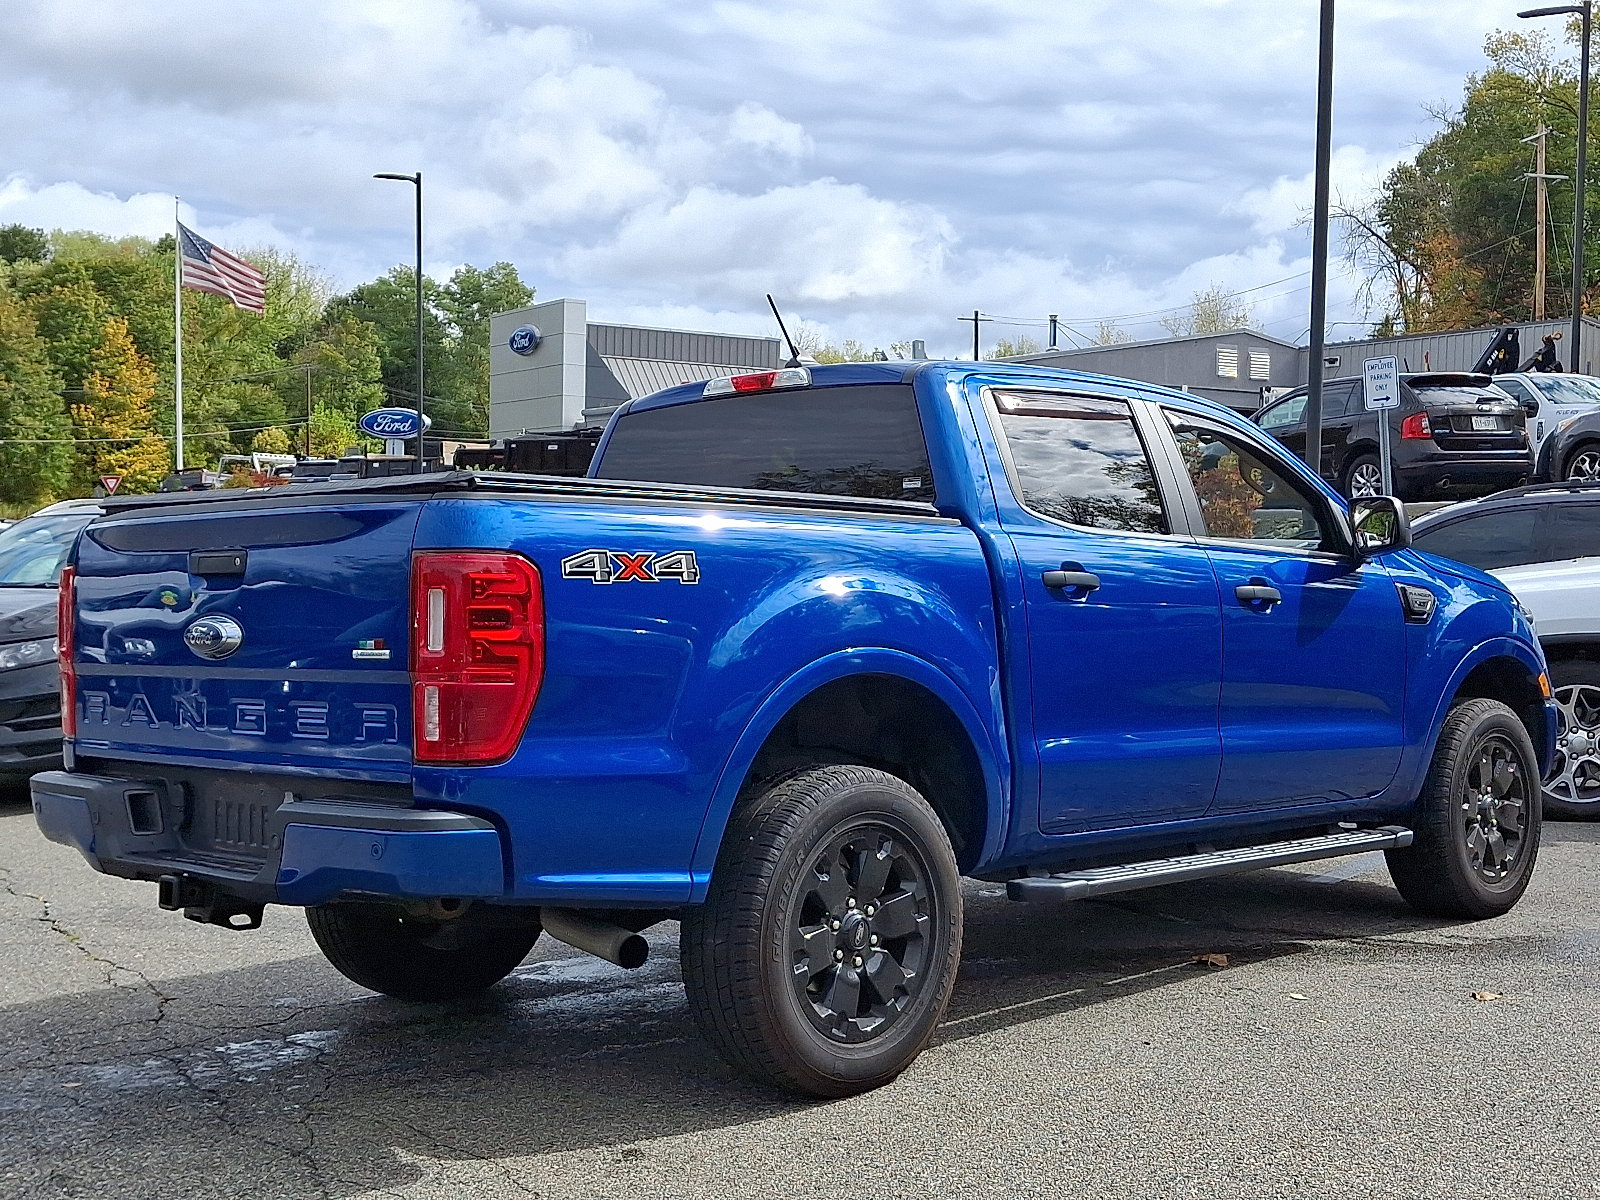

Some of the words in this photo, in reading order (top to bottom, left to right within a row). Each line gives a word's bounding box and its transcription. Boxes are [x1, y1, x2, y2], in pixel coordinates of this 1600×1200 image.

[513, 331, 530, 349] Ford
[1367, 361, 1394, 371] EMPLOYEE
[1370, 373, 1392, 381] PARKING
[1375, 384, 1388, 392] ONLY
[373, 414, 413, 432] Ford
[186, 626, 214, 645] Ford
[82, 690, 399, 743] RANGER
[771, 849, 806, 963] GRABBER
